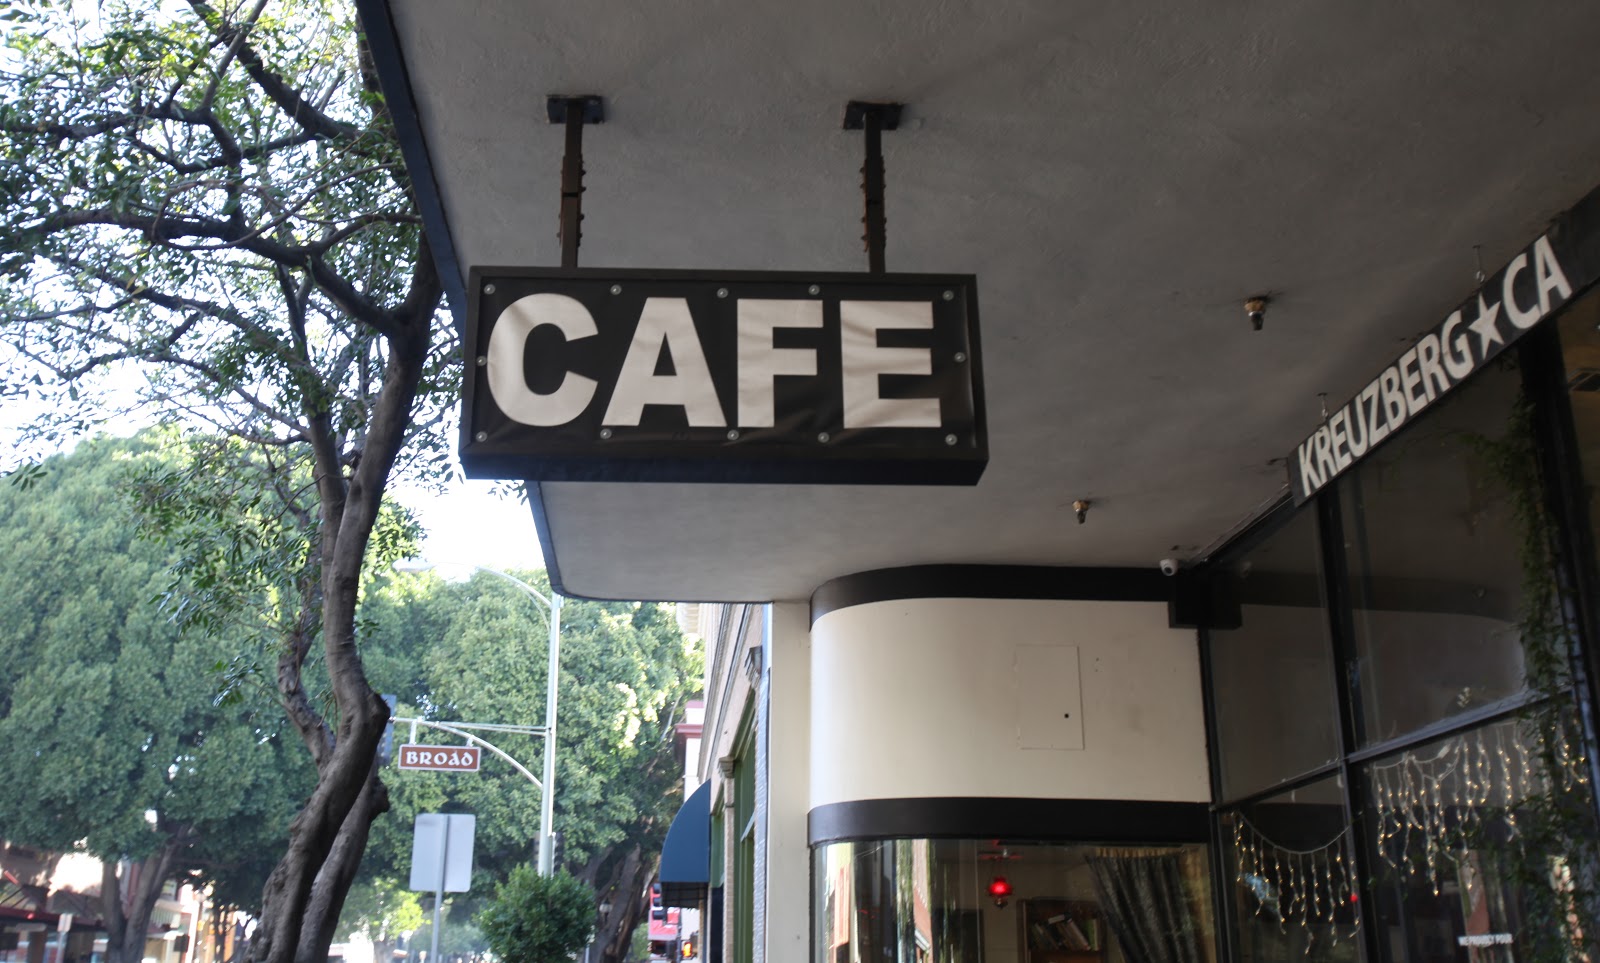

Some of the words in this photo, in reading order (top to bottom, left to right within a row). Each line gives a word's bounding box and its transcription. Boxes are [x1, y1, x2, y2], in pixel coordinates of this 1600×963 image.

[486, 292, 942, 429] CAFE
[1298, 309, 1475, 498] KREUZBERG
[1502, 234, 1572, 330] CA
[405, 750, 474, 767] BROAD
